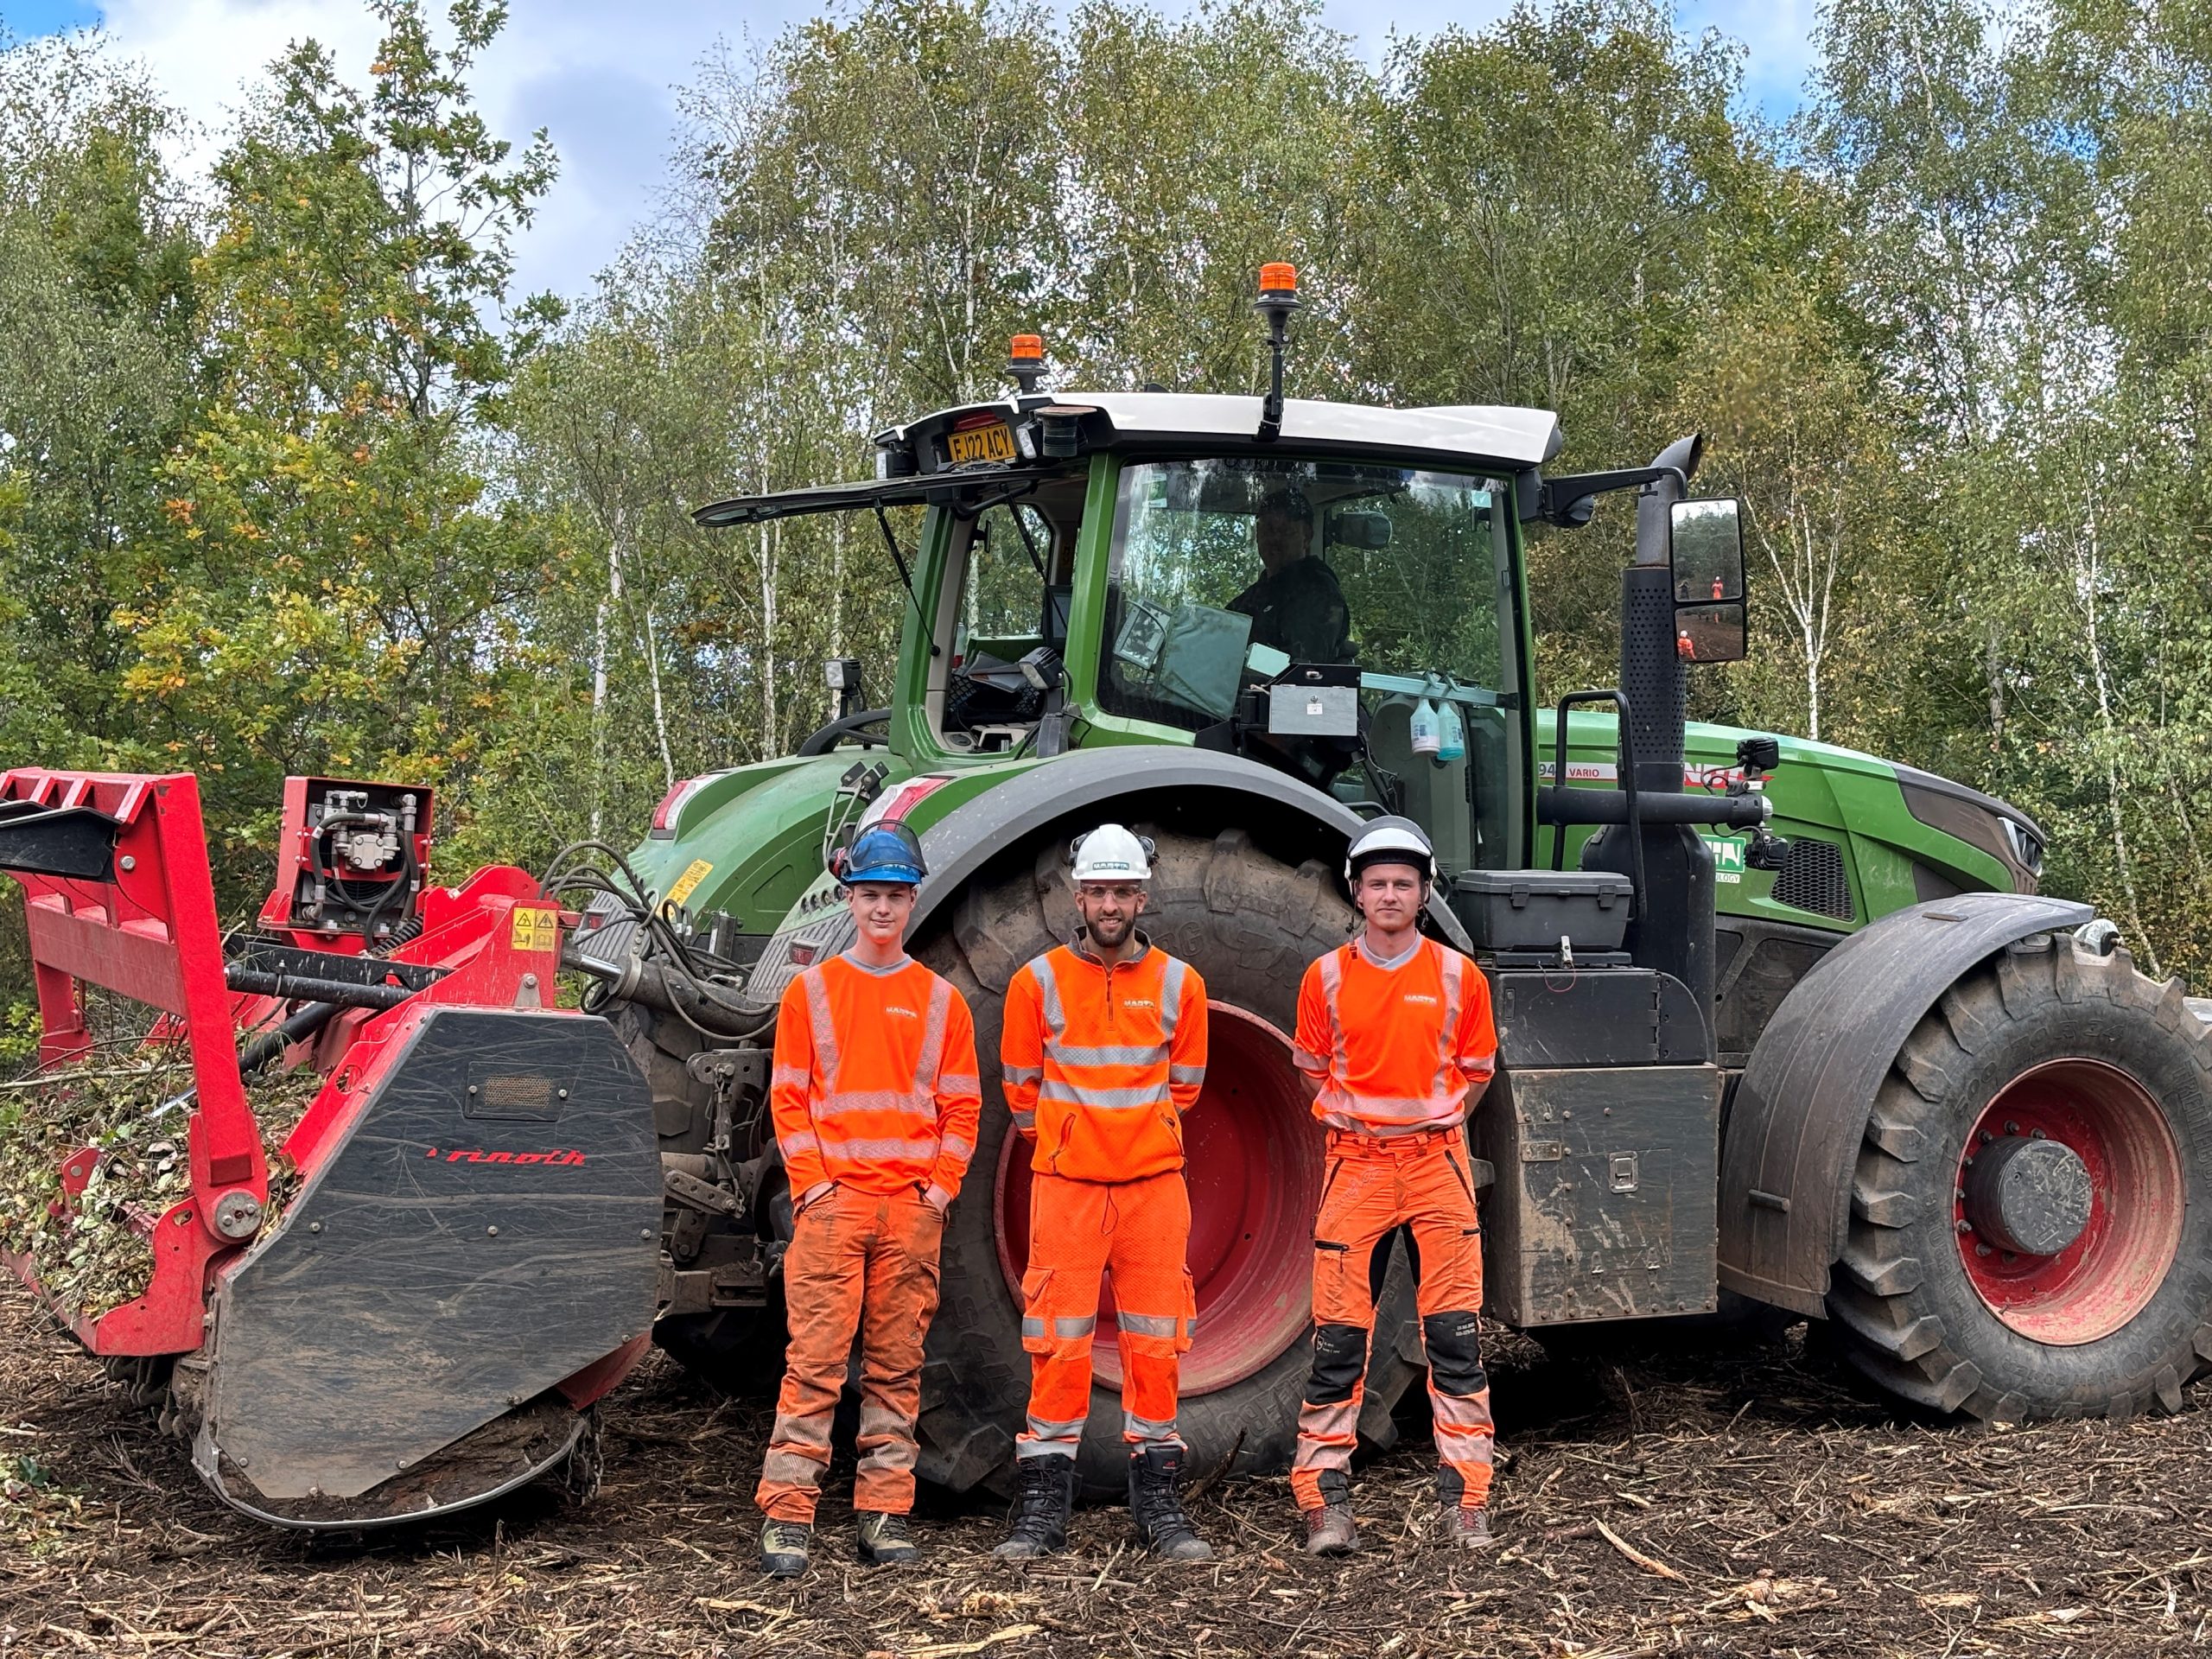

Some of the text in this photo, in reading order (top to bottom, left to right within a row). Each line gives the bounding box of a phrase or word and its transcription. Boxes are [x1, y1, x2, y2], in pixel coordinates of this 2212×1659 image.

[953, 429, 1010, 461] FJ22 ACY
[1539, 763, 1599, 778] 94 VARIO
